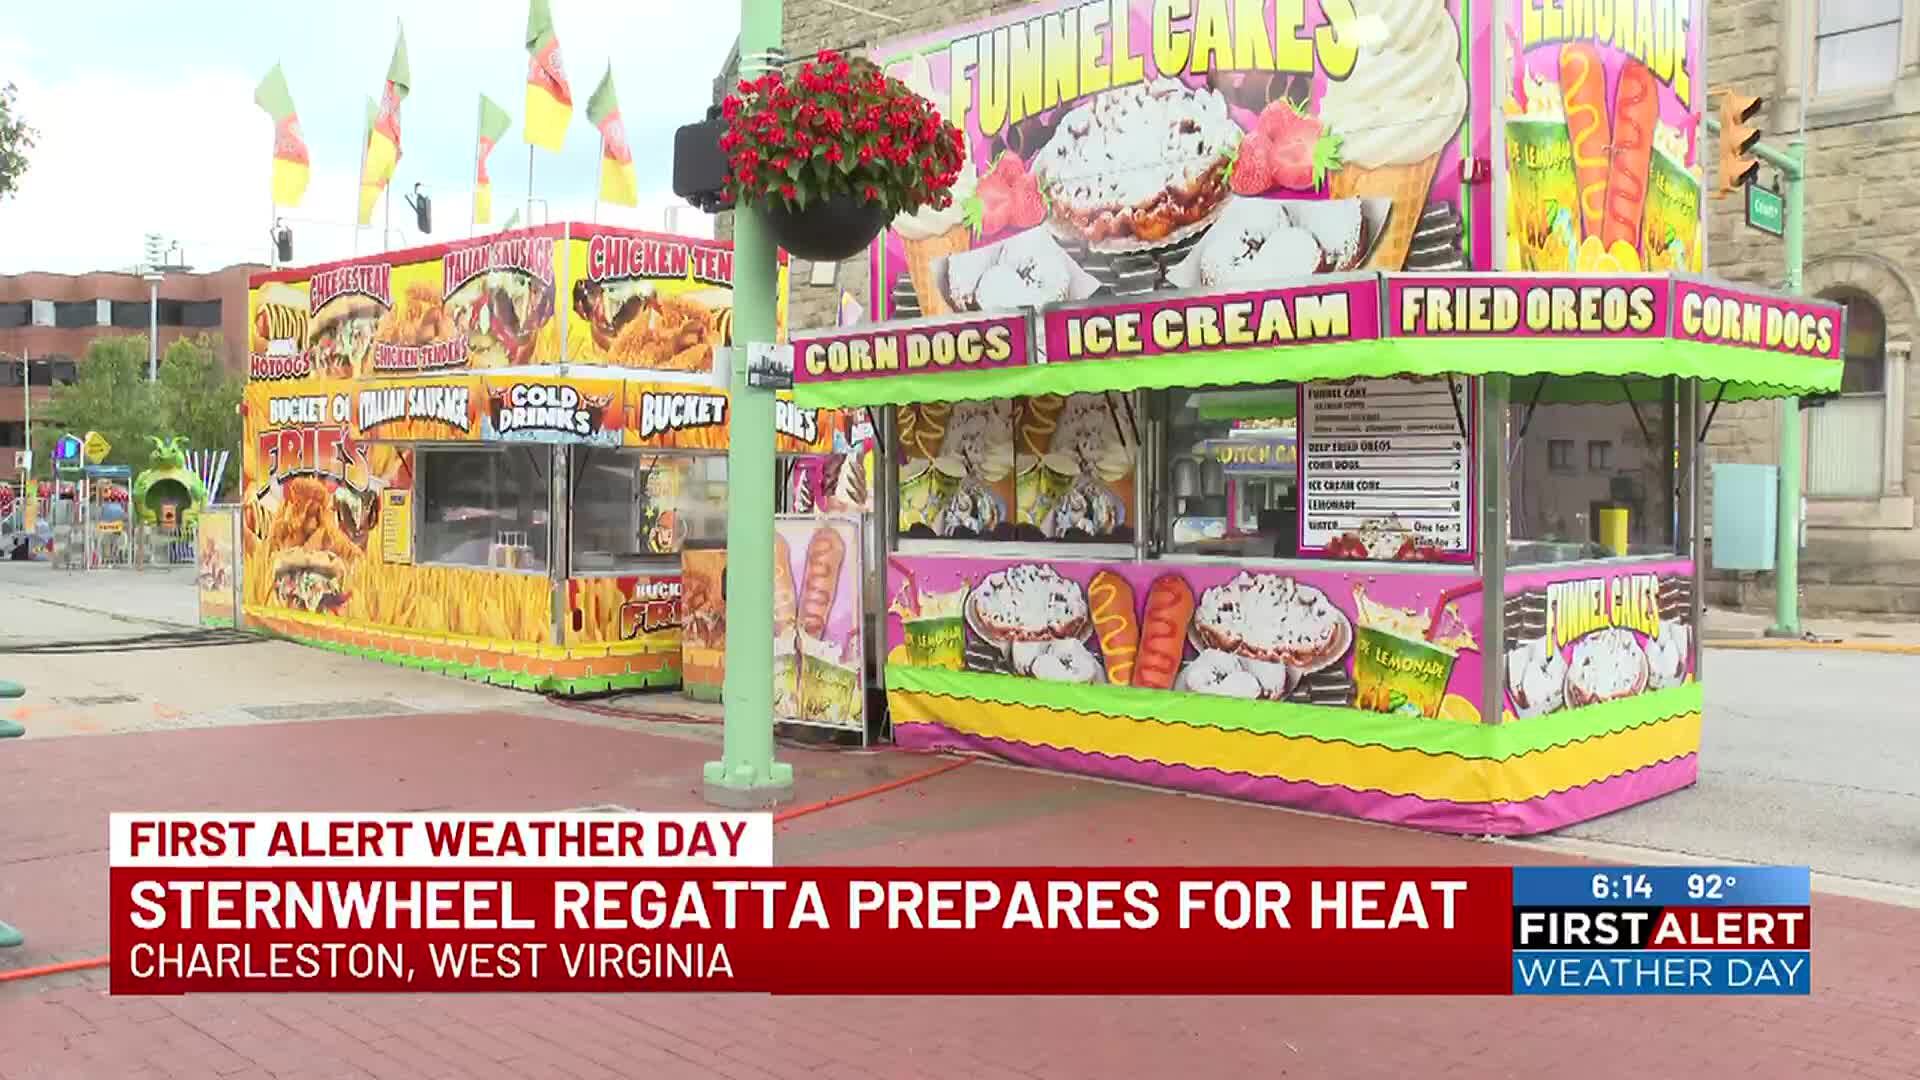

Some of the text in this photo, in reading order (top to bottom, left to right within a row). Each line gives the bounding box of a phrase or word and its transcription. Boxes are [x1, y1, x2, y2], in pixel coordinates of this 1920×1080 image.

[949, 0, 1360, 137] FUNNEL CAKES
[442, 237, 553, 303] ITALIAN SAUSAGE
[588, 234, 735, 285] CHICKEN TEN
[310, 263, 392, 317] CHEESESTEAK
[1401, 286, 1654, 333] FRIED OREOS
[1066, 292, 1350, 356] ICE CREAM
[1682, 291, 1833, 354] CORN DOGS
[373, 336, 469, 370] CHICKEN TENDERS
[805, 326, 1013, 375] CORN DOGS
[269, 396, 328, 424] BUCKET
[359, 386, 470, 434] ITALIAN SAUSAGE
[510, 383, 579, 408] COLD
[499, 406, 592, 436] DRINKS
[640, 392, 729, 441] BUCKET
[775, 400, 818, 445] RIES
[1360, 440, 1391, 452] OREOS
[1308, 480, 1322, 491] ICE
[1356, 480, 1381, 491] CONE
[1308, 499, 1356, 510] LEMONADE
[1414, 521, 1433, 532] One
[1435, 522, 1449, 532] for
[636, 582, 682, 600] BUCK
[619, 601, 682, 640] FRI
[1546, 572, 1660, 662] FUNNEL CAKES
[1376, 647, 1445, 680] LEMONADE
